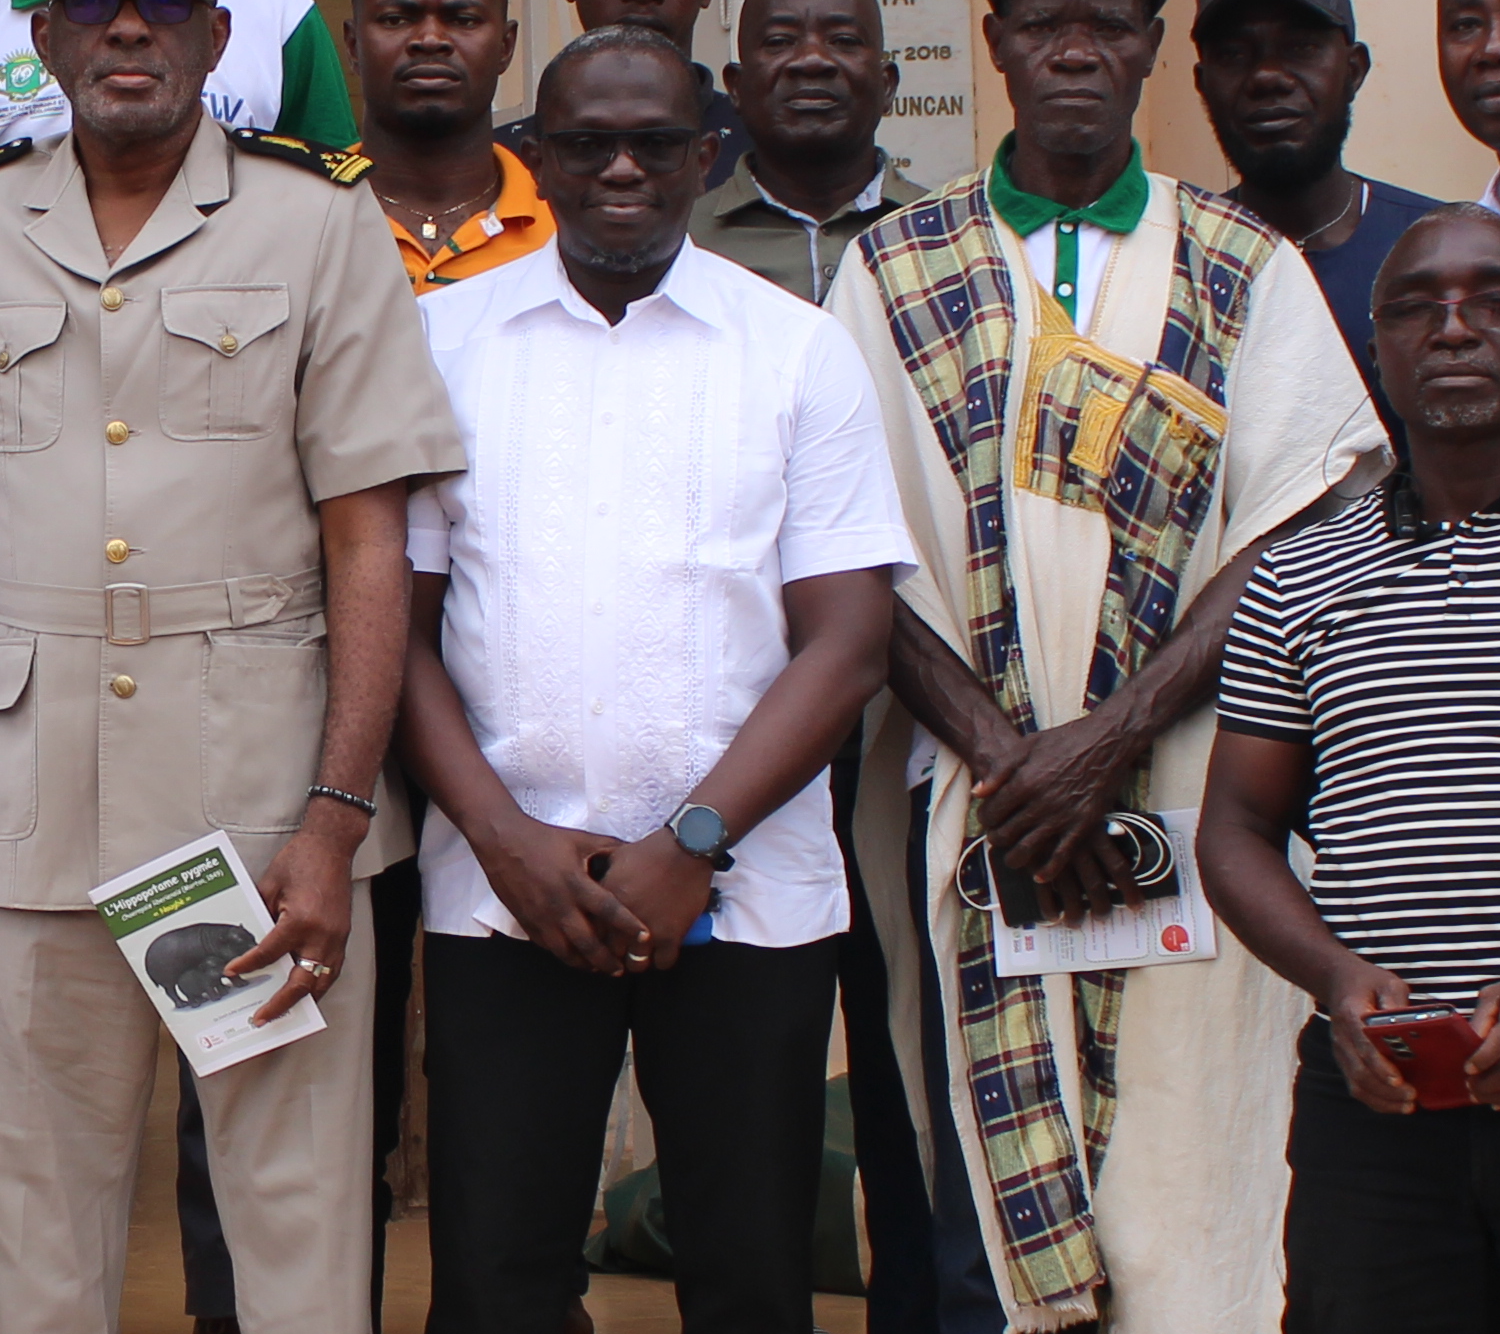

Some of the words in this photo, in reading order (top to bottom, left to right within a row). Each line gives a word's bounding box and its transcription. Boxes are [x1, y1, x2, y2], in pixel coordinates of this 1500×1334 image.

[904, 45, 952, 61] 2018
[104, 875, 179, 917] L'Hippopotame
[181, 856, 221, 883] pygmée
